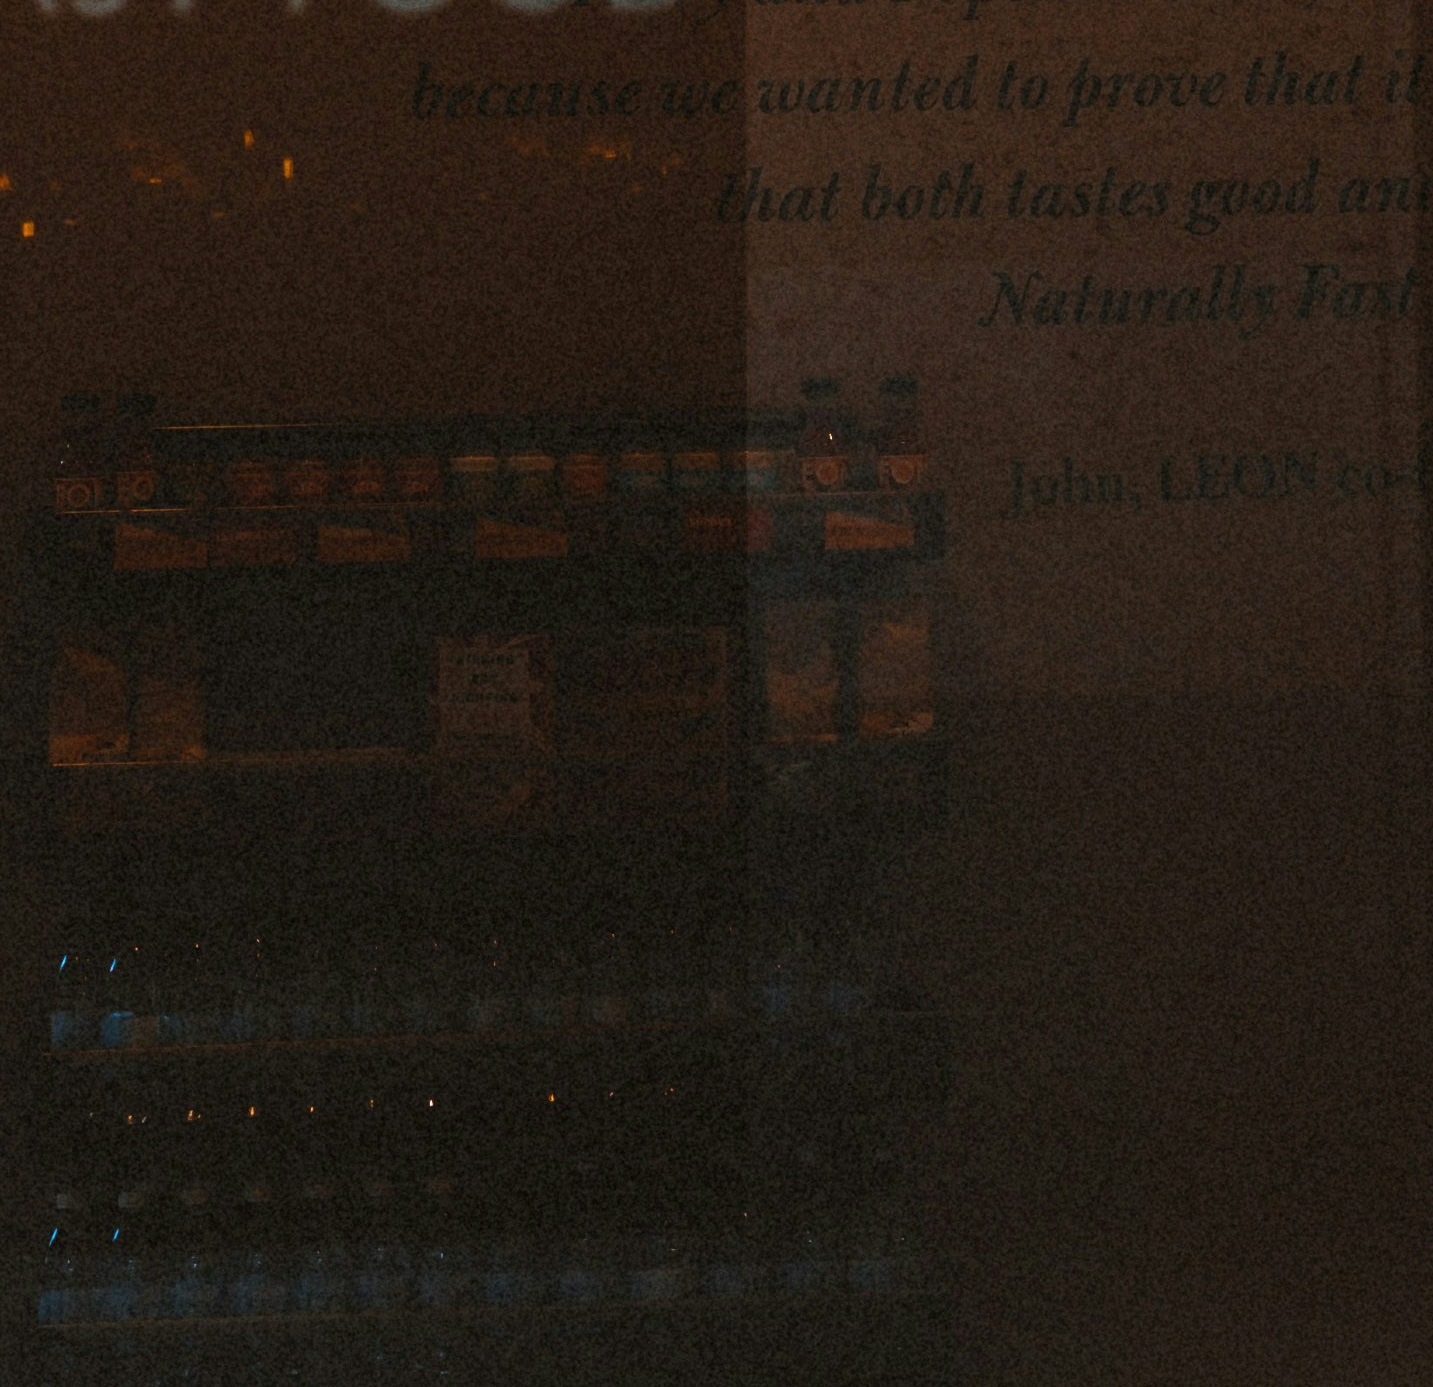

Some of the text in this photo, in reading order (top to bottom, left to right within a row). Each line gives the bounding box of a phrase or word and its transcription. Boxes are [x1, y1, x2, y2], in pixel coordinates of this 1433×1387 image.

[410, 60, 646, 119] because
[664, 80, 742, 116] we
[758, 54, 979, 115] wanted
[997, 61, 1052, 114] to
[1060, 58, 1228, 128] prove
[1244, 53, 1369, 110] that
[1386, 53, 1429, 108] it
[714, 166, 841, 223] that
[860, 162, 985, 221] both
[1007, 167, 1171, 221] tastes
[1183, 158, 1322, 234] good
[978, 260, 1420, 340] Naturally Fast
[1157, 450, 1319, 502] LEON
